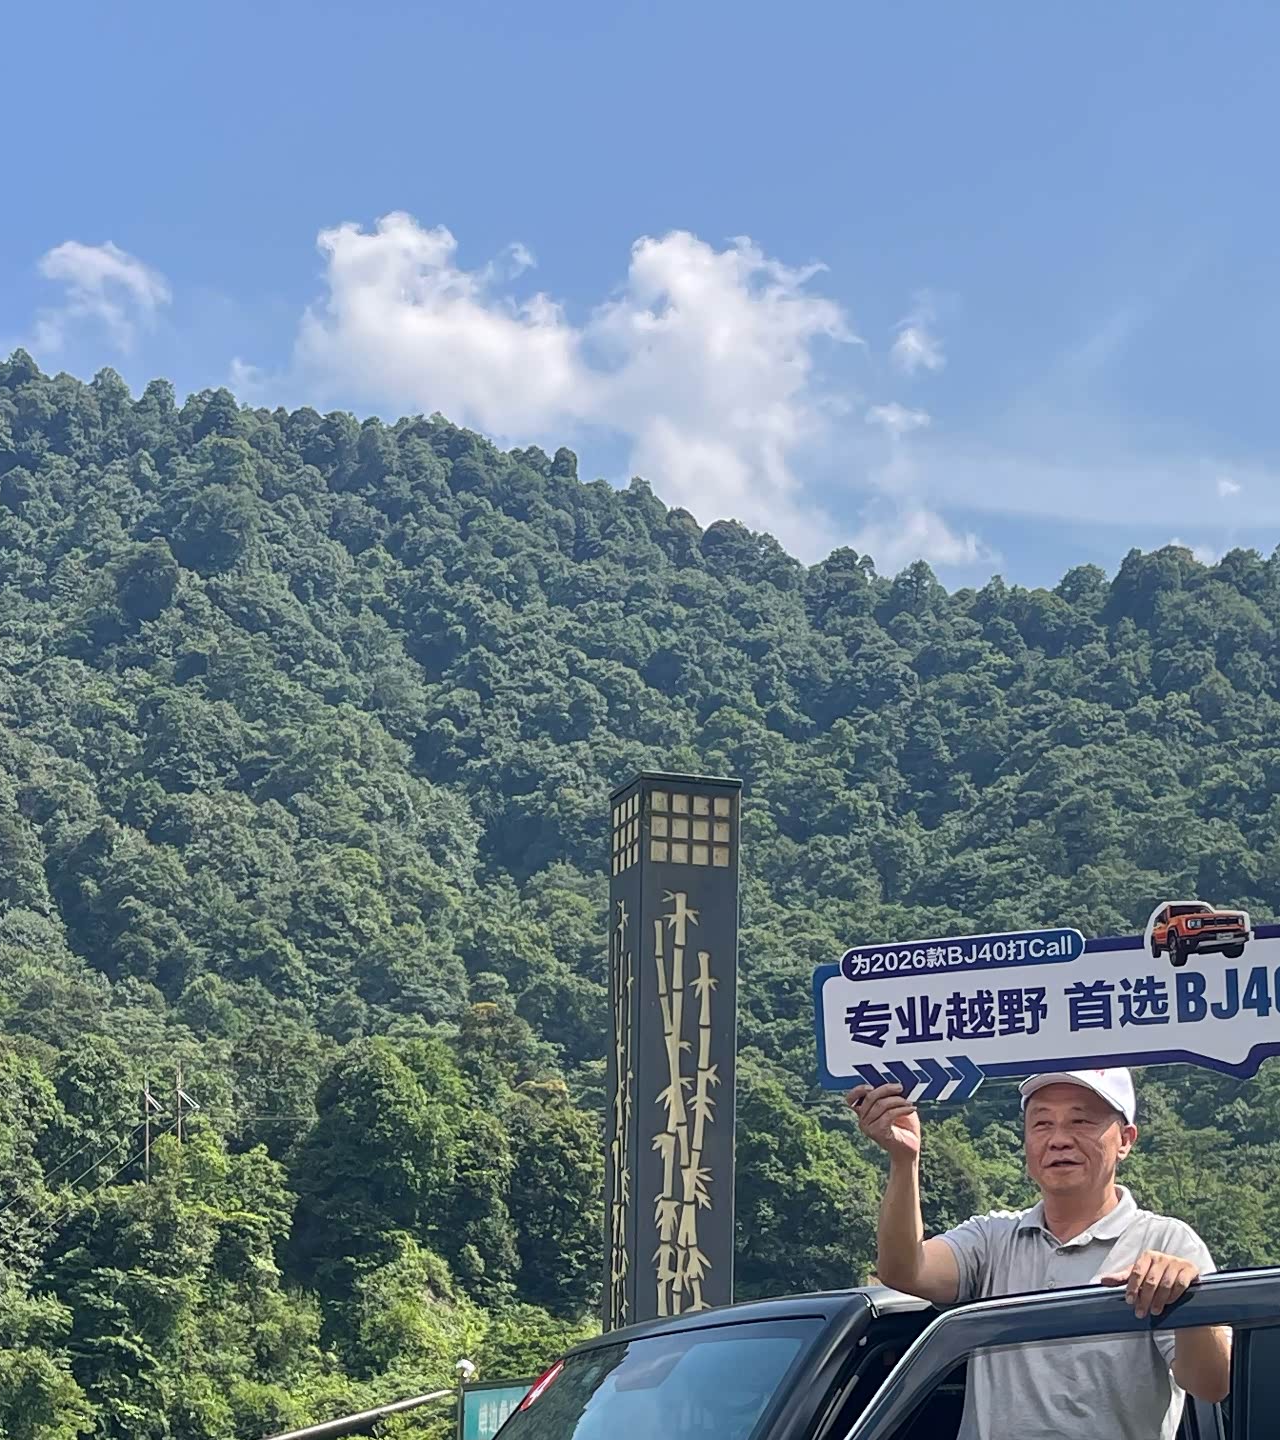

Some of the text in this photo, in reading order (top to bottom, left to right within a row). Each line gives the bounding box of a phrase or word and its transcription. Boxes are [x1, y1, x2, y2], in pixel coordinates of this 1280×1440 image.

[850, 935, 1074, 977] 为2026款BJ40打Call
[844, 986, 1049, 1049] 专业越野
